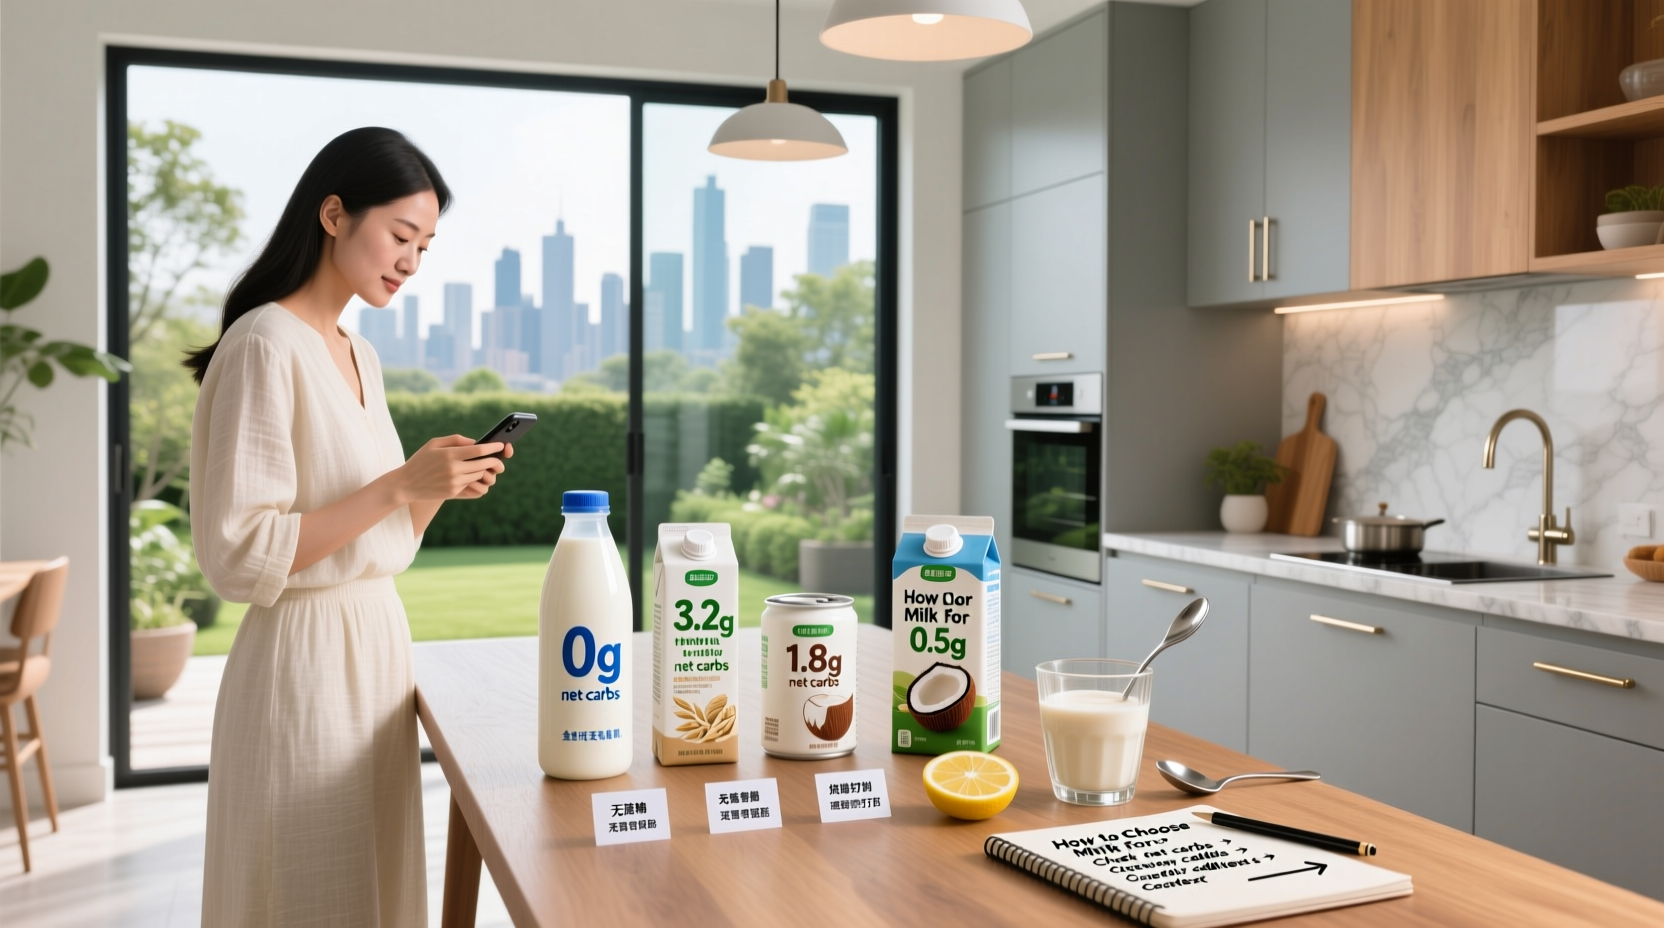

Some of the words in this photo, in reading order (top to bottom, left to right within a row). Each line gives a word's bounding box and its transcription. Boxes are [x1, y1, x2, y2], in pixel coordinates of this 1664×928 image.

[904, 589, 939, 606] How
[673, 598, 734, 638] 3.2g
[904, 607, 938, 623] Milk
[944, 608, 970, 625] For
[909, 626, 967, 660] 0.5g
[562, 626, 622, 684] 0g
[674, 660, 694, 672] net
[696, 657, 729, 671] carbs
[786, 643, 842, 677] 1.8g
[561, 689, 583, 701] net
[586, 687, 621, 701] carbs
[789, 677, 808, 688] net
[1051, 836, 1095, 850] How
[1121, 822, 1191, 839] Choose
